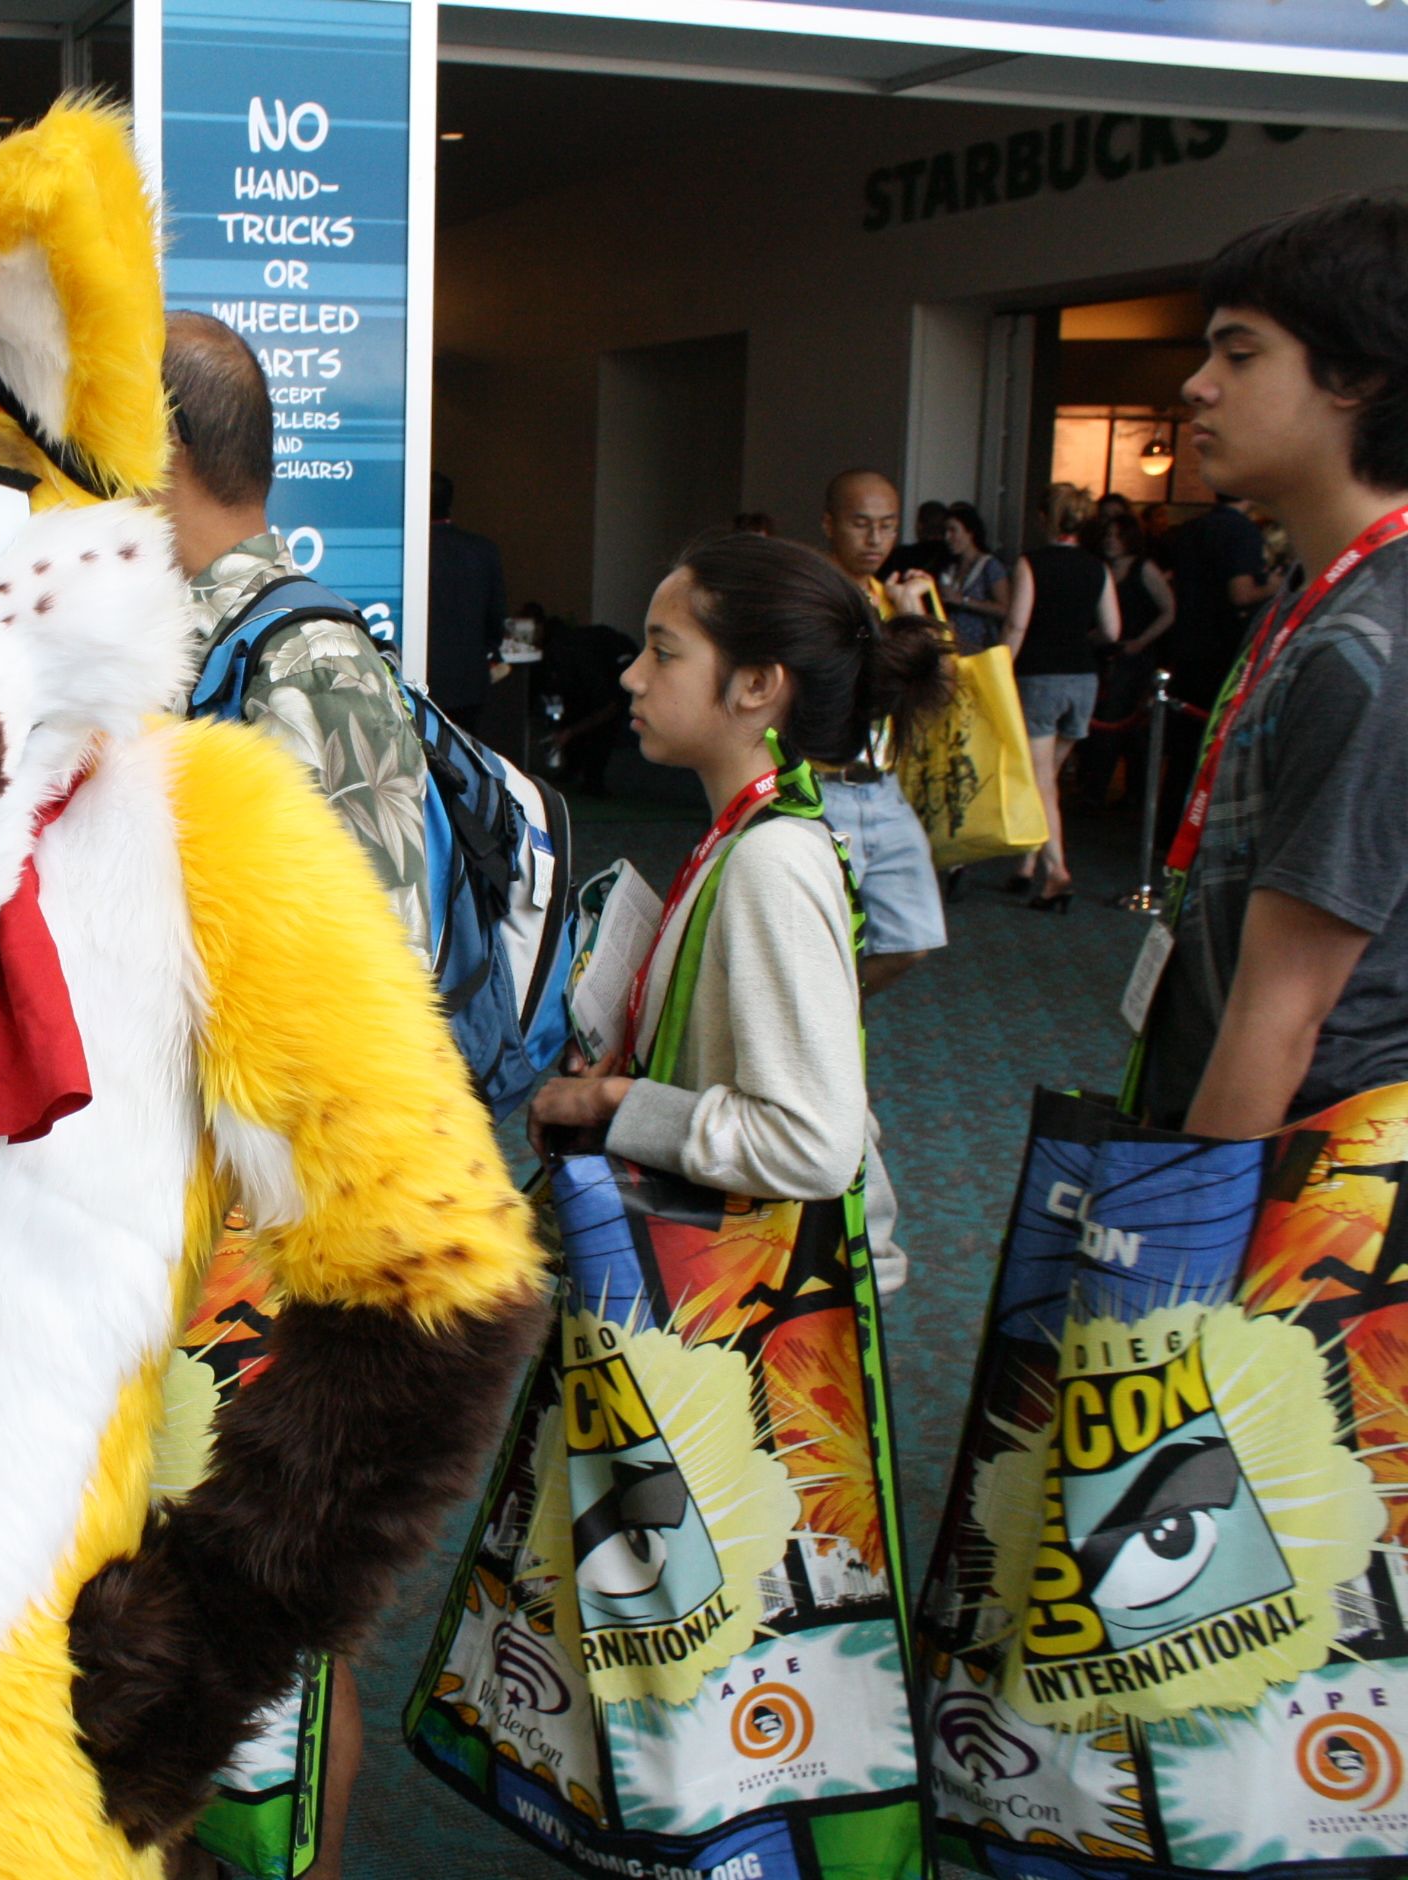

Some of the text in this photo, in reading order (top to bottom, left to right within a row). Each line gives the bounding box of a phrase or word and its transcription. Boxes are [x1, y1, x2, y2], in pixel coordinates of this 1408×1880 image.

[248, 96, 329, 153] NO
[235, 166, 339, 201] HAND-
[861, 113, 1229, 233] STARBUCKS
[217, 212, 355, 247] TRUCKS
[263, 259, 309, 289] OR
[212, 301, 360, 334] WHEELED
[257, 347, 341, 379] ARTS
[273, 412, 340, 430] OLLERS
[273, 460, 353, 480] CHAIRS)
[564, 1358, 658, 1450] CN
[1064, 1339, 1212, 1471] CON
[582, 1594, 734, 1672] RNATIONAL
[1024, 1597, 1307, 1704] INTERNATIONAL
